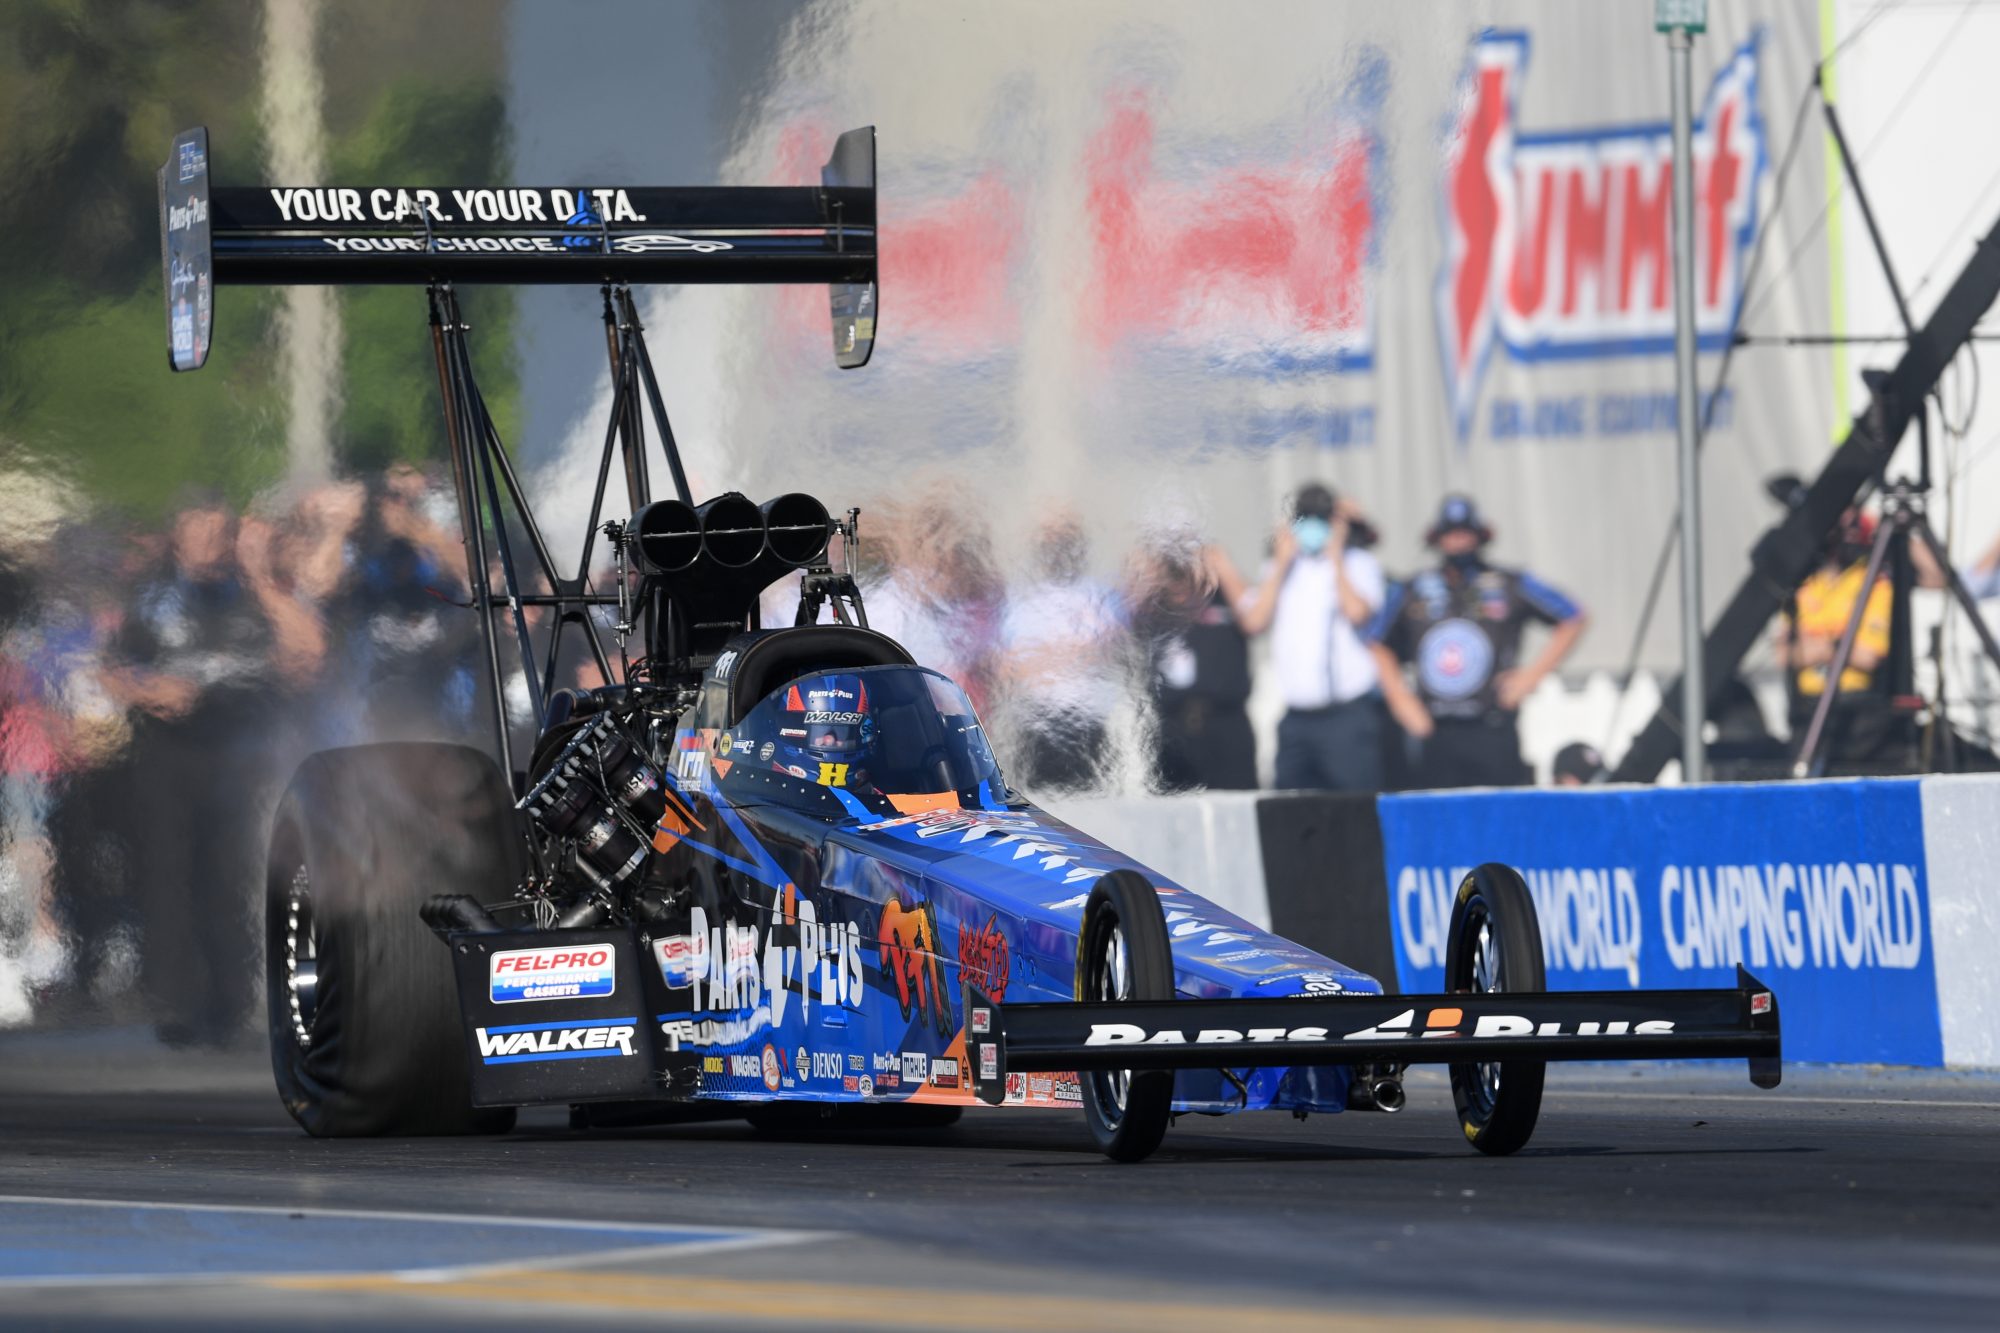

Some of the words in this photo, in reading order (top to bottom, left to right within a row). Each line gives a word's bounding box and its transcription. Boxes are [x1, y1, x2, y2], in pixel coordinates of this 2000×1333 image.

[271, 188, 365, 221] YOUR
[371, 188, 453, 222] CAR.
[453, 189, 547, 222] YOUR
[550, 189, 646, 224] DATA.
[1445, 55, 1755, 388] SUMMT
[323, 237, 417, 252] YOUR
[434, 237, 567, 252] CHOICE.
[803, 711, 864, 725] WALSH
[816, 762, 850, 787] H
[1659, 864, 1801, 971] CAMPING
[1799, 862, 1922, 970] WORLD
[495, 951, 608, 974] FEL-PRO
[691, 906, 759, 1012] PARTS
[800, 900, 863, 1025] PLUS
[502, 971, 600, 989] PERFORMANCE
[523, 984, 581, 999] GASKETS
[475, 1026, 635, 1057] WALKER
[704, 1057, 723, 1073] MOOG
[731, 1055, 761, 1077] WAGNER
[813, 1052, 842, 1079] DENSO
